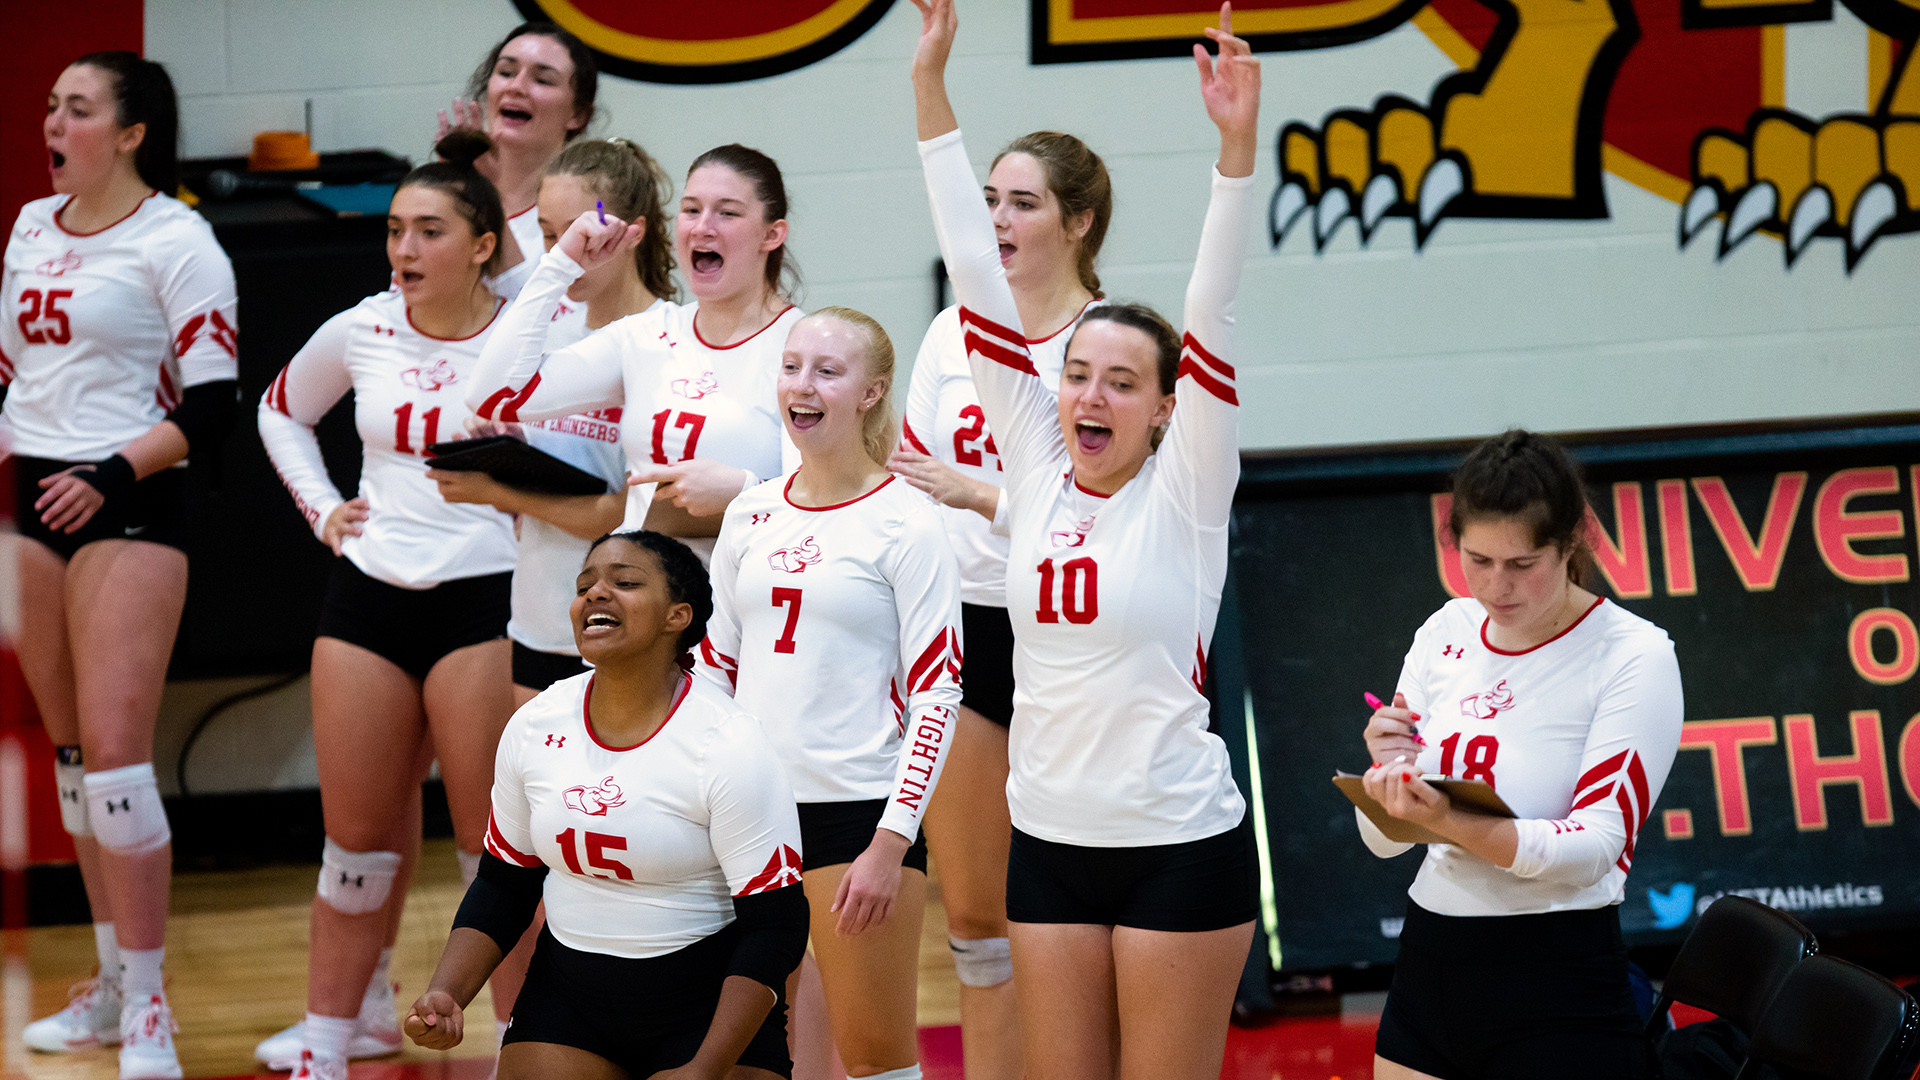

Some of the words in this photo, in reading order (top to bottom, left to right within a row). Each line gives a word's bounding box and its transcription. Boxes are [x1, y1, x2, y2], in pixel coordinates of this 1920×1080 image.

[18, 288, 74, 345] 25
[393, 402, 442, 458] 11
[549, 416, 619, 444] ENGINEERS
[649, 408, 707, 465] 17
[1035, 556, 1099, 625] 10
[771, 586, 803, 655] 7
[1849, 607, 1920, 685] O
[1439, 731, 1500, 792] 18
[555, 827, 635, 881] 15
